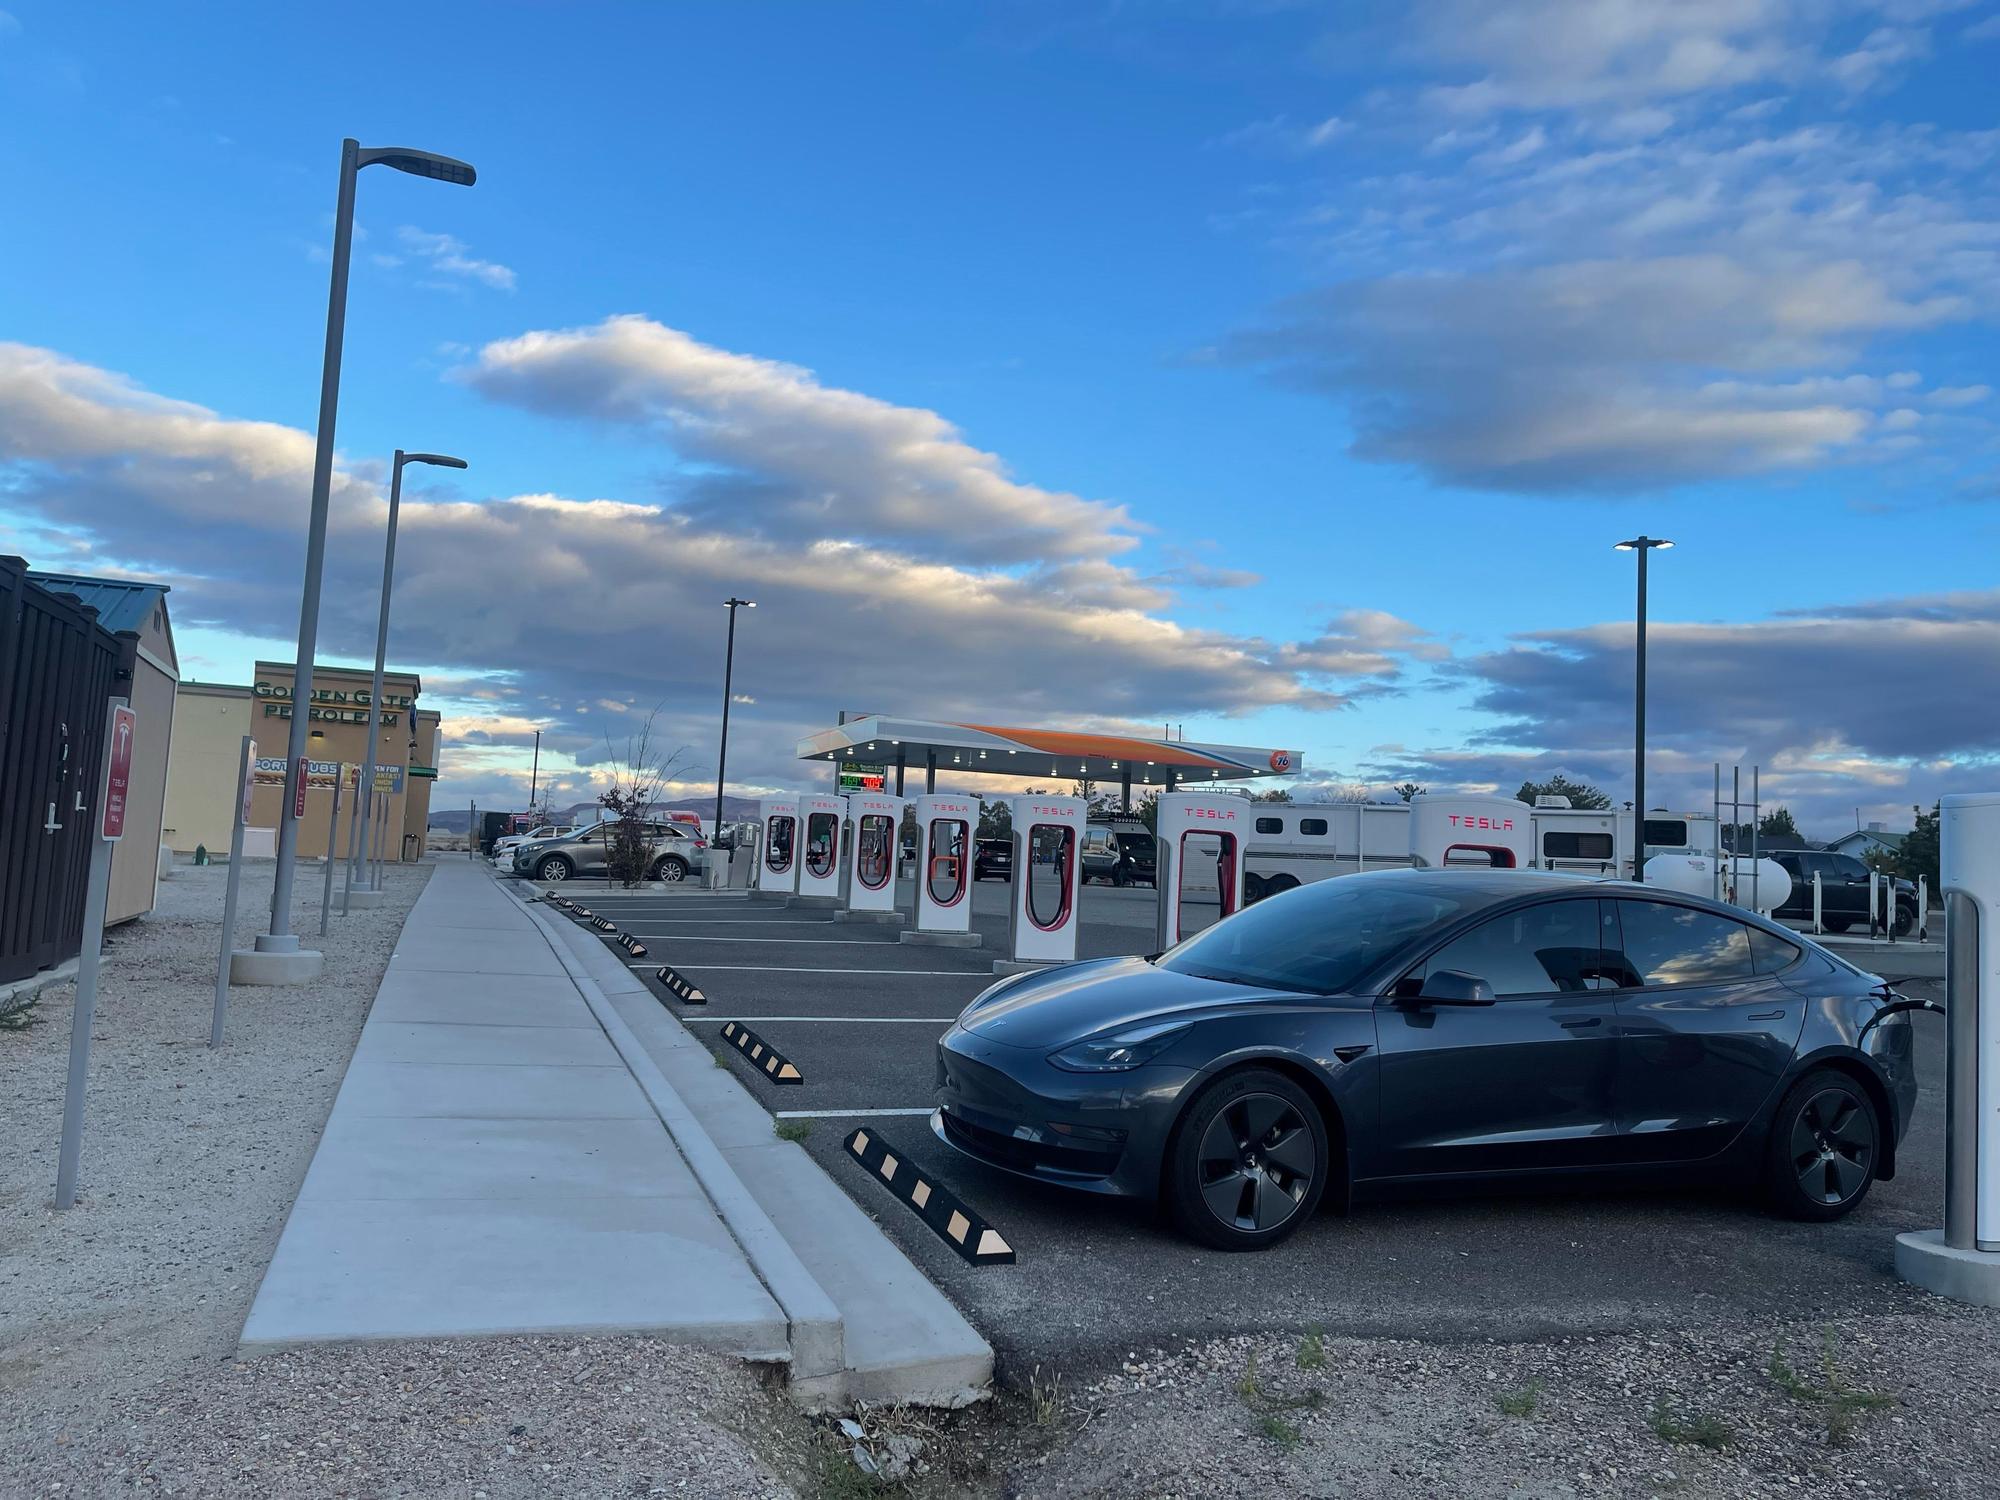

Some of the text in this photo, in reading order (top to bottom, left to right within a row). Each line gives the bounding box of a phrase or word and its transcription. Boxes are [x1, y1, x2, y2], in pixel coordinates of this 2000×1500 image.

[354, 690, 412, 710] GTE
[264, 704, 398, 727] PEROLEM
[310, 762, 337, 774] UBS
[811, 801, 838, 809] TESLA
[932, 803, 968, 812] TESLA
[1033, 806, 1074, 816] TESLA
[1184, 808, 1235, 820] TESLA
[1448, 815, 1513, 831] TESLA
